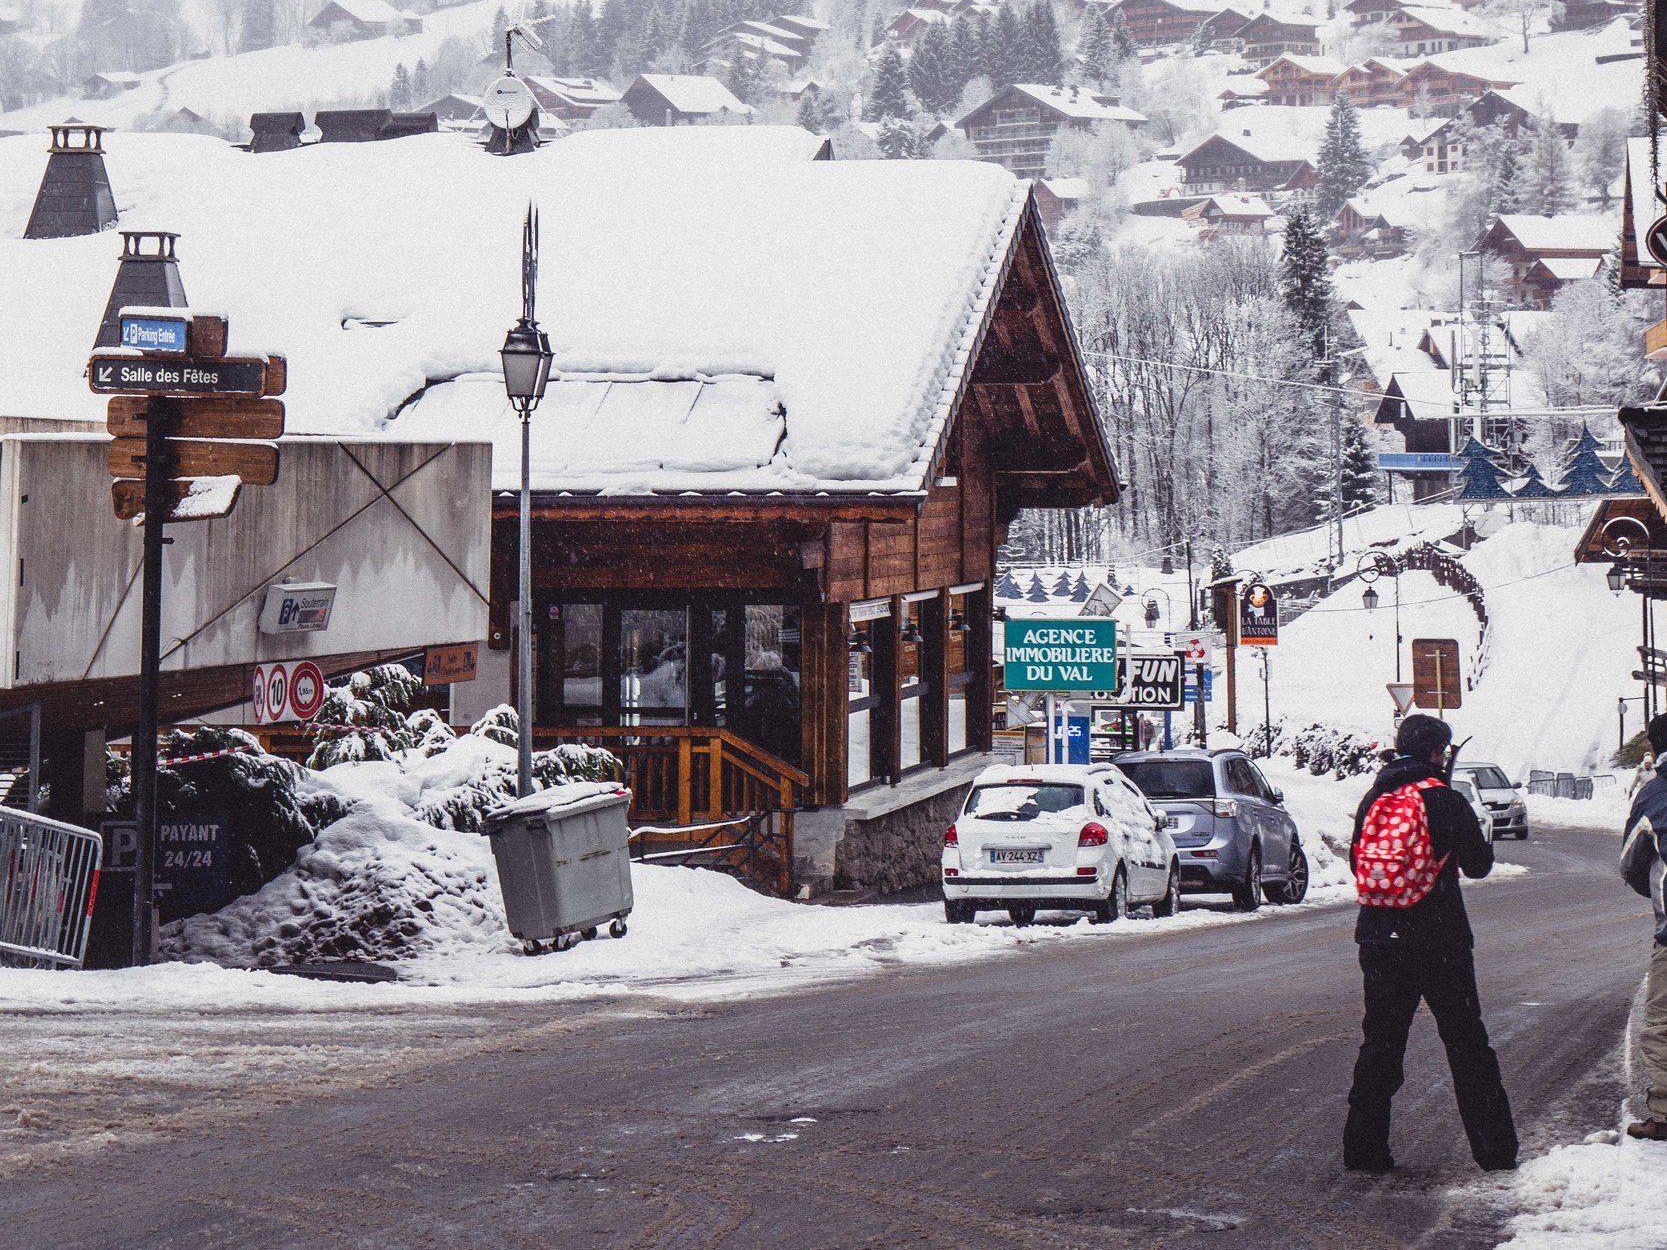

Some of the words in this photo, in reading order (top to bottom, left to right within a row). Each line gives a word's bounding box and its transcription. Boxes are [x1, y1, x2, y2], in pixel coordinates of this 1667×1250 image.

[138, 326, 158, 345] Parking
[121, 366, 152, 382] Salle
[156, 368, 179, 383] des
[183, 368, 219, 384] Fêtes
[1023, 628, 1097, 645] AGENCE
[1005, 647, 1114, 663] IMMOBILIERE
[1026, 665, 1053, 681] DU
[1057, 665, 1093, 681] VAL
[1130, 660, 1178, 683] FUN
[271, 678, 284, 706] 10
[160, 824, 220, 842] PAYANT
[112, 828, 138, 866] P
[164, 850, 213, 869] 24/24
